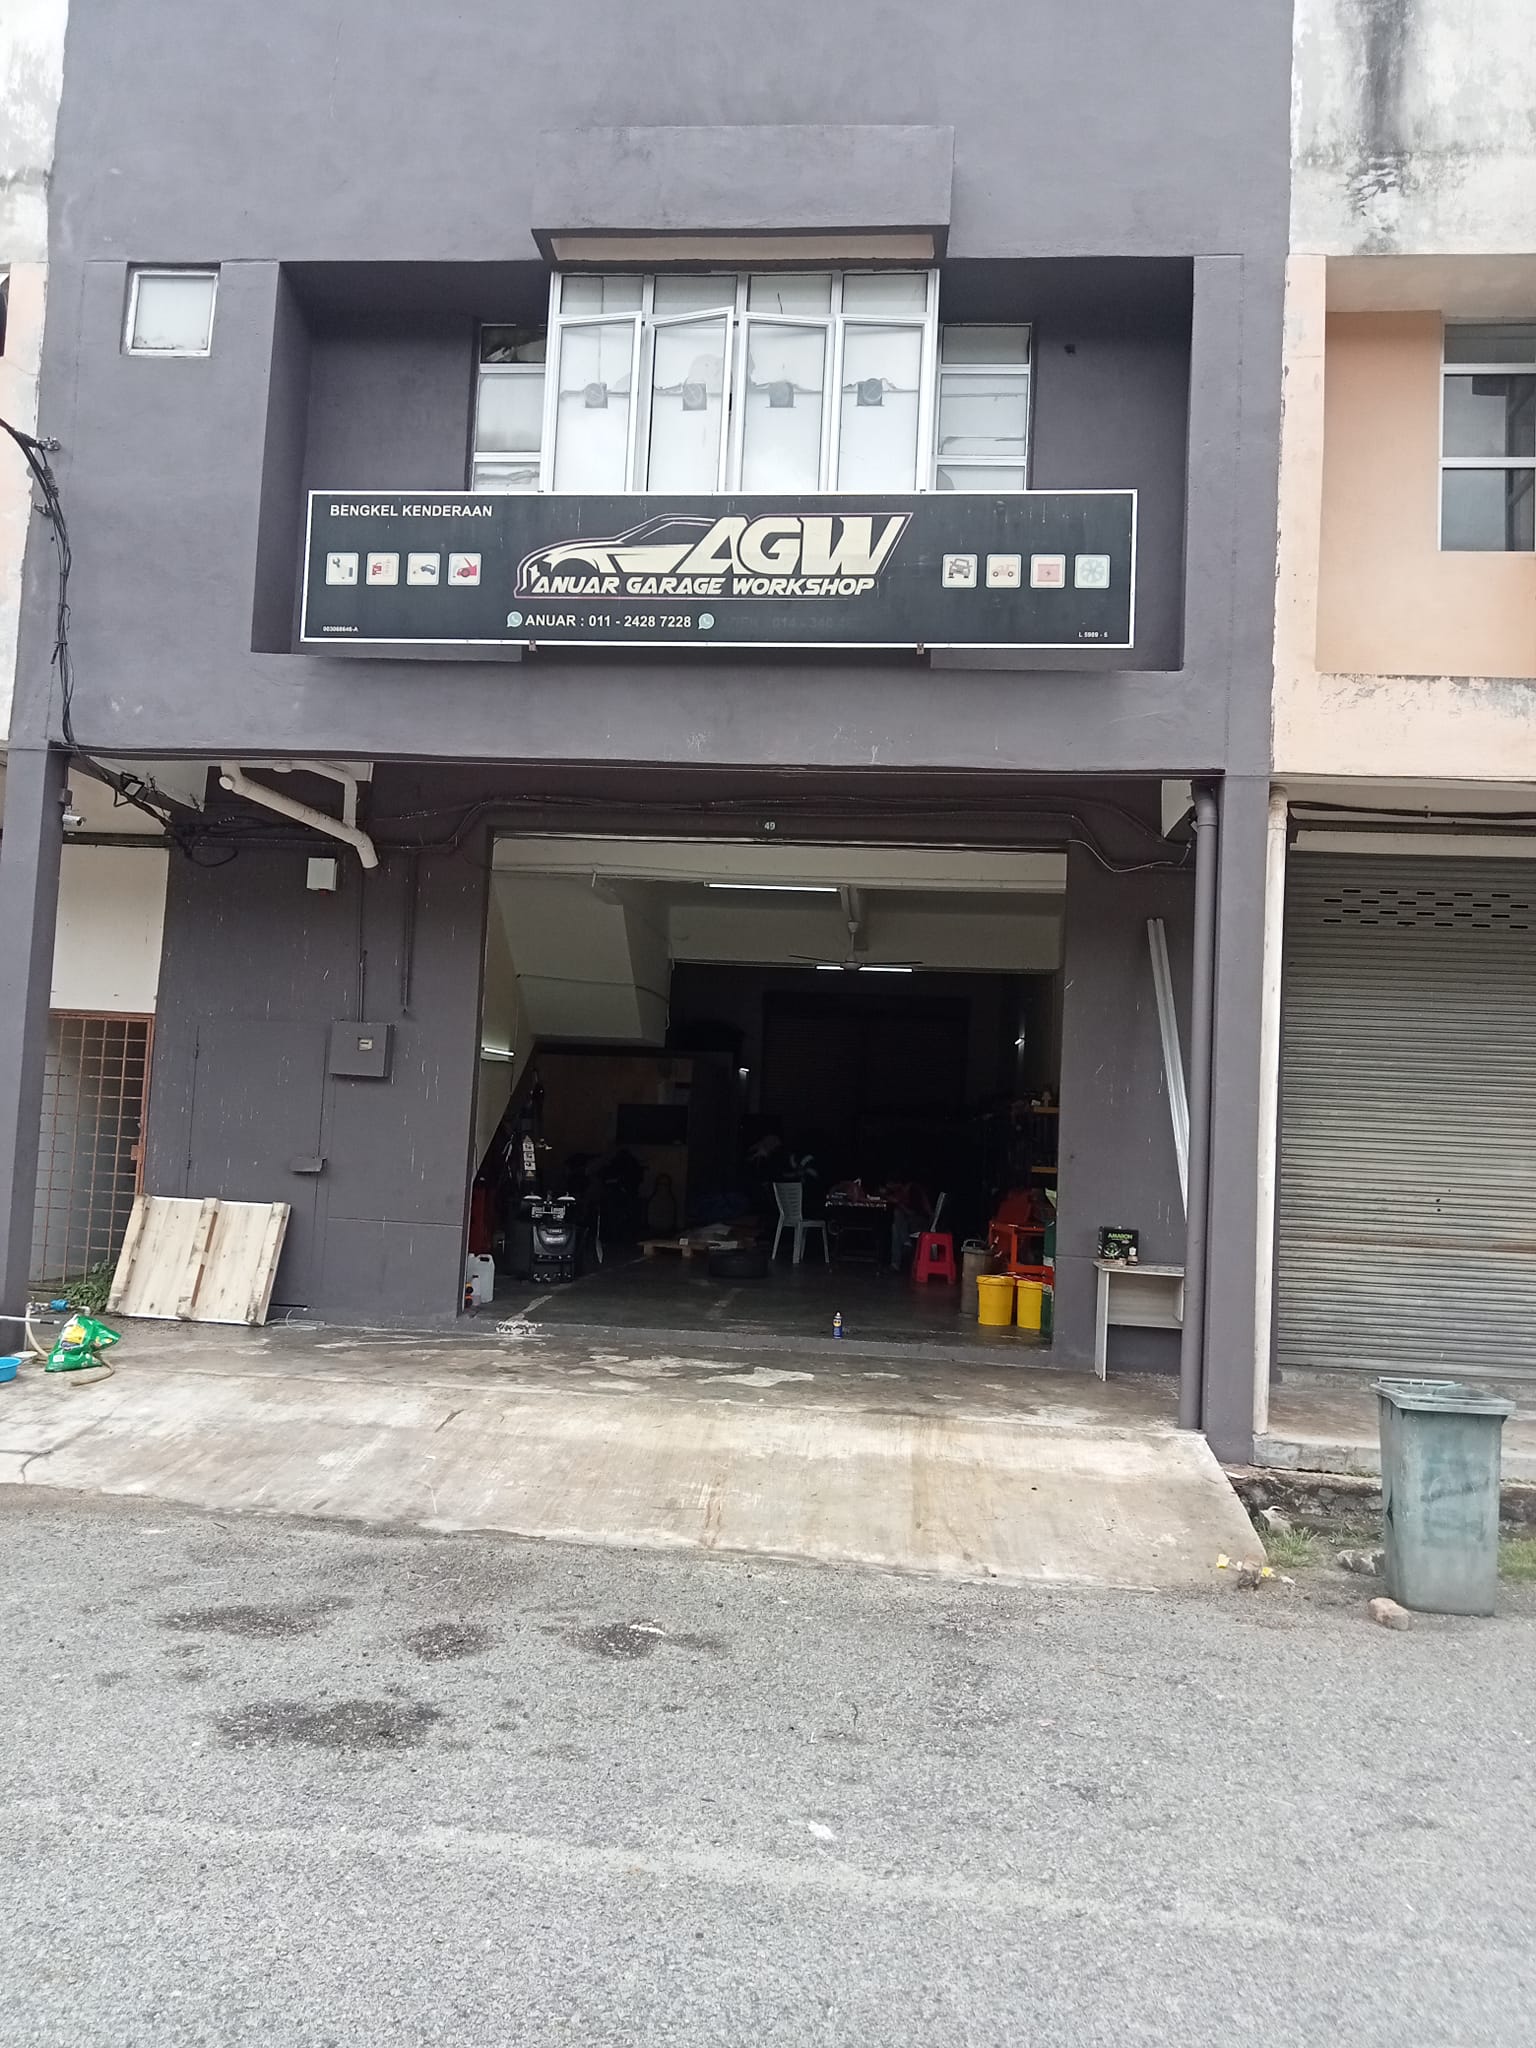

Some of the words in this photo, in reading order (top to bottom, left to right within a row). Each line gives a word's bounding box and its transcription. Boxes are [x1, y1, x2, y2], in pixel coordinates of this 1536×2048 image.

[330, 504, 398, 517] BENGKEL
[402, 505, 492, 517] KENDERAAN
[675, 516, 906, 575] AGW
[532, 576, 630, 594] ANUAR
[626, 577, 725, 595] GARAGE
[733, 578, 875, 595] WORKSHOP
[525, 615, 576, 627] ANUAR
[588, 615, 611, 627] 011
[624, 616, 656, 627] 2428
[660, 616, 692, 628] 7228
[764, 821, 776, 831] 49
